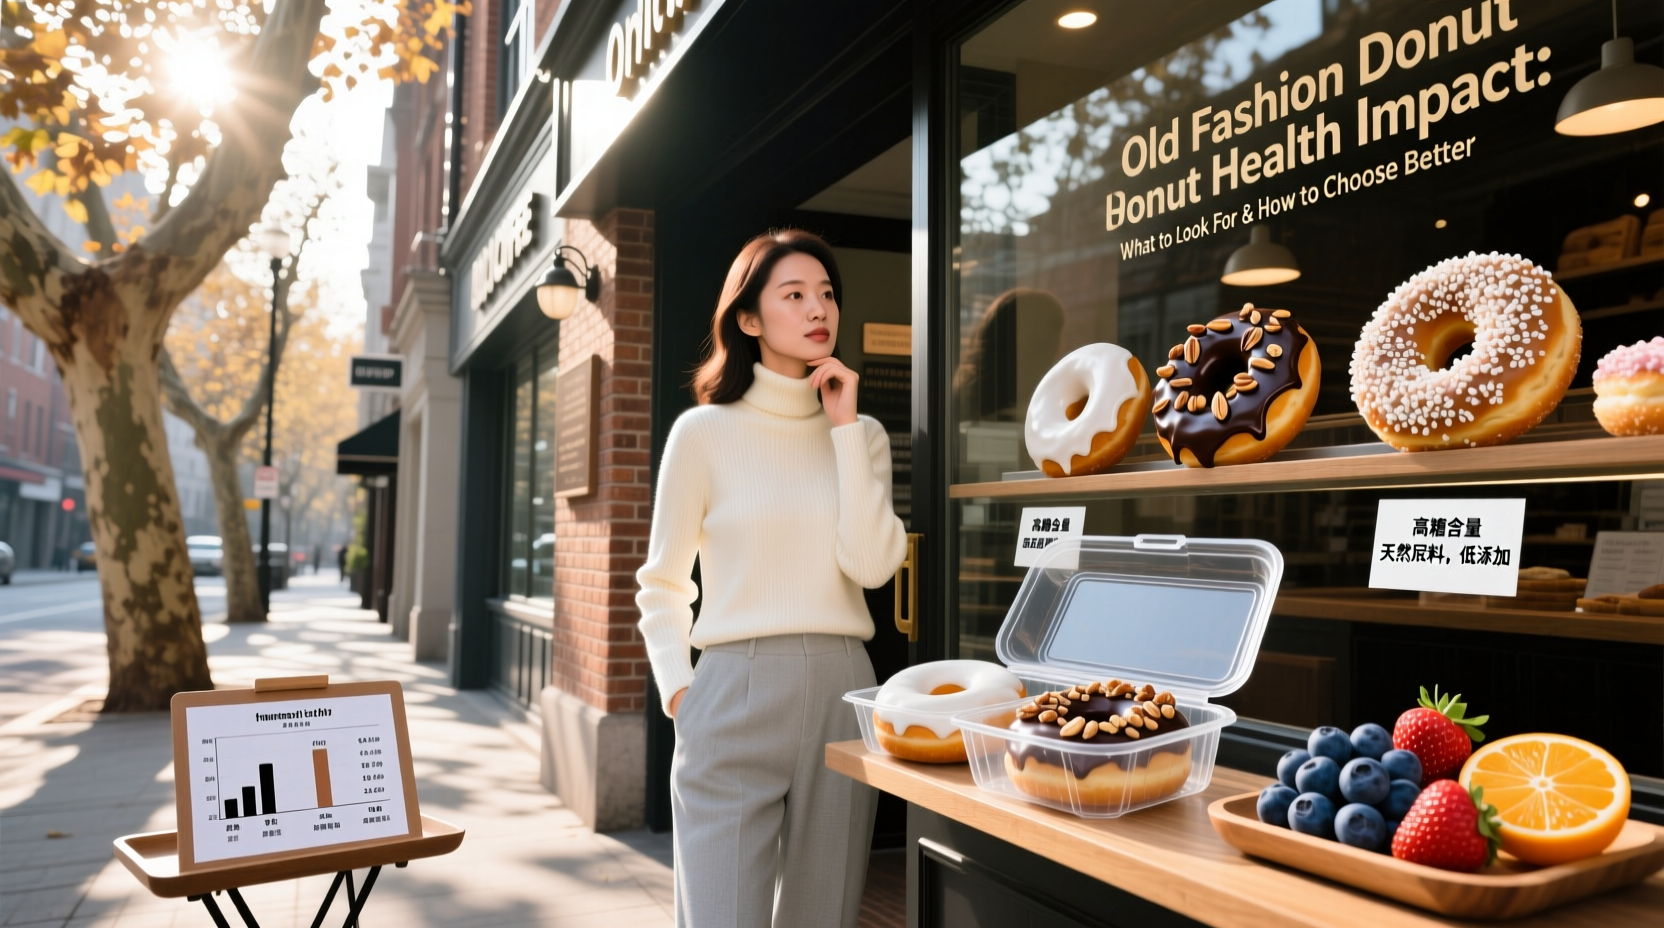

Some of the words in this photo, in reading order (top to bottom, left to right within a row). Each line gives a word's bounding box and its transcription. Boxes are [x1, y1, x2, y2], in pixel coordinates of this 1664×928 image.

[1121, 118, 1179, 177] Old
[1191, 63, 1343, 152] Fashion
[1358, 0, 1518, 86] Donut
[1212, 112, 1341, 196] Health
[1358, 44, 1552, 146] Impact:
[1120, 235, 1155, 260] What
[1159, 232, 1172, 249] to
[1176, 216, 1210, 245] Look
[1213, 210, 1238, 234] For
[1242, 203, 1254, 225] &
[1258, 192, 1296, 221] How
[1300, 186, 1319, 207] to
[1324, 161, 1399, 199] Choose
[1404, 136, 1476, 176] Better
